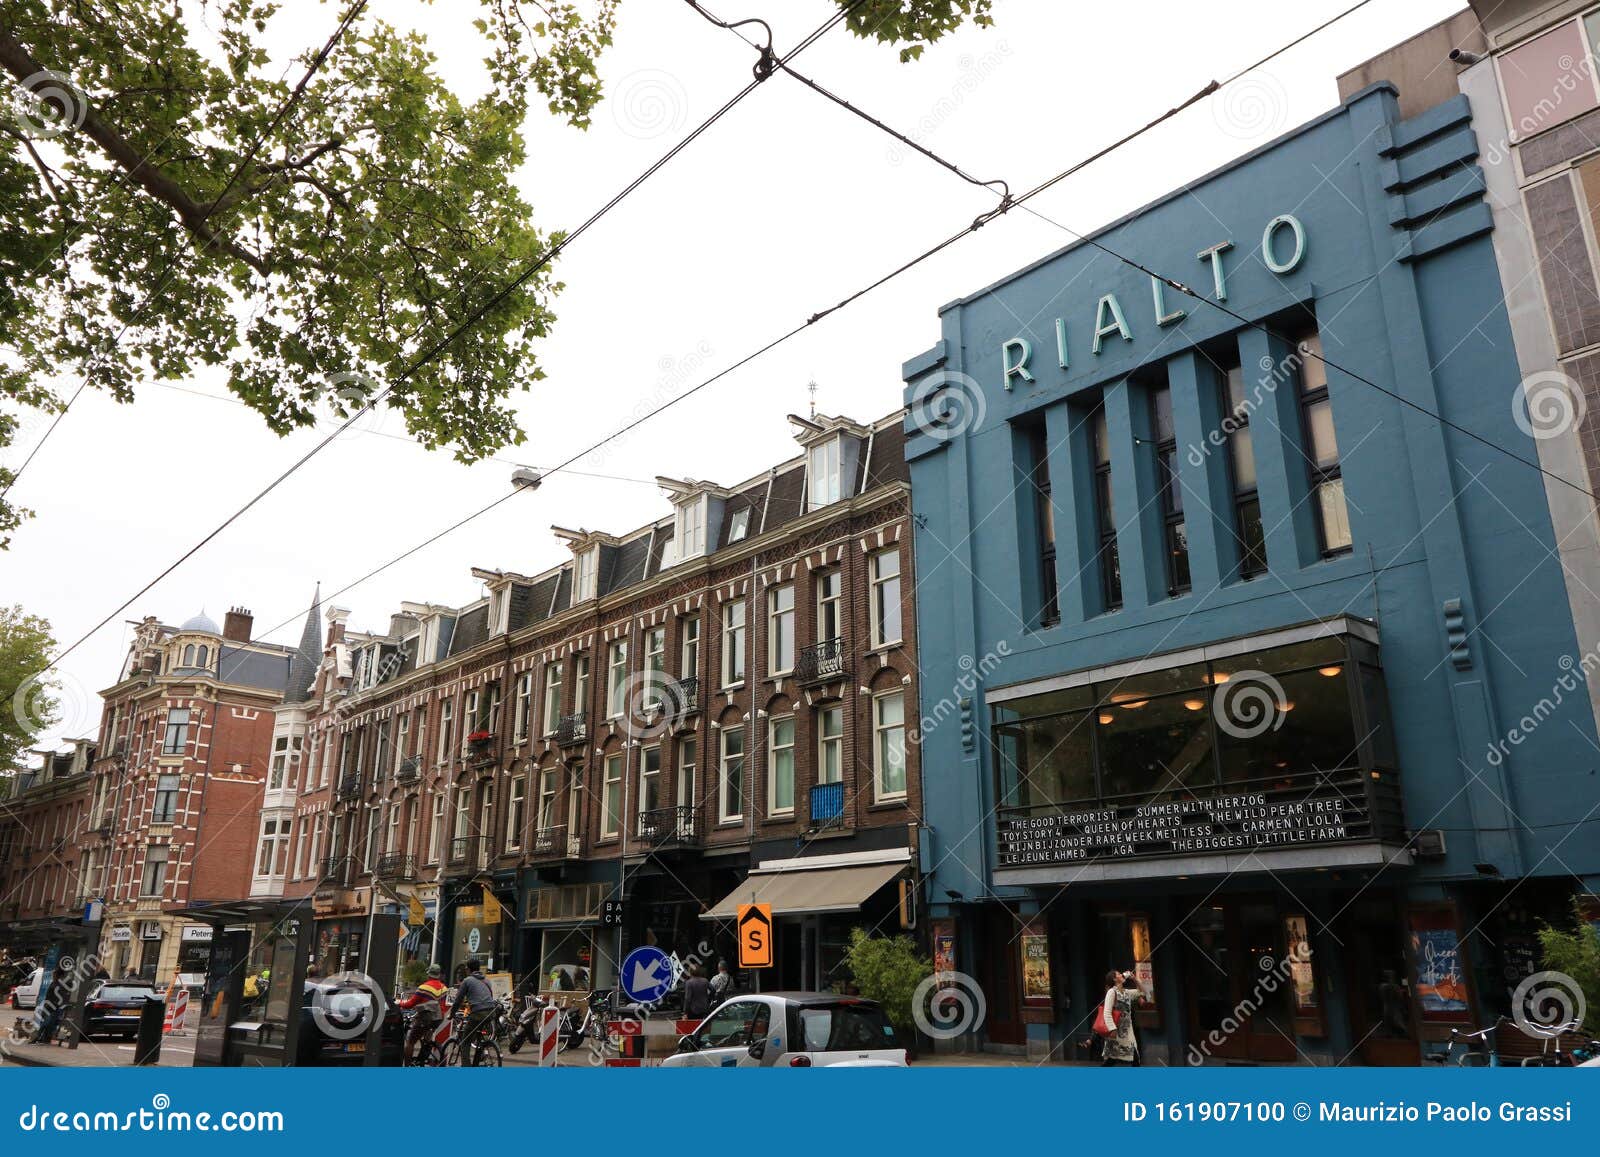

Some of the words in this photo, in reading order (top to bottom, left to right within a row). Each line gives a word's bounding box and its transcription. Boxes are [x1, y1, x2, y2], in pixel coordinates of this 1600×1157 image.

[1002, 214, 1306, 392] RIALTO
[1137, 804, 1180, 818] SUMMER
[1182, 800, 1212, 812] WITH
[1217, 795, 1264, 809] HERZOG
[1210, 811, 1232, 822] THE
[1235, 808, 1266, 820] WILD
[1270, 804, 1304, 817] PEAR
[1308, 800, 1342, 812] TREE
[1011, 821, 1028, 830] THE
[1030, 818, 1054, 828] GOOD
[1057, 811, 1115, 825] TERRORIST
[1084, 823, 1119, 834] QUEEN
[1121, 820, 1133, 831] OF
[1137, 816, 1180, 829] HEARTS
[1243, 818, 1292, 832] CARMEN
[1295, 817, 1302, 828] Y
[1306, 814, 1341, 827] LOLA
[1003, 832, 1020, 841] TOY
[1022, 830, 1053, 840] STORY
[1055, 828, 1061, 836] 4
[1009, 842, 1033, 852] MIJN
[1035, 836, 1092, 850] BIJZONDER
[1096, 833, 1122, 845] RARE
[1125, 831, 1153, 842] WEEK
[1156, 828, 1177, 840] MET
[1182, 825, 1211, 837] TESS
[1172, 839, 1193, 851] THE
[1196, 835, 1250, 849] BIGGEST
[1256, 830, 1306, 844] LITTLE
[1310, 827, 1345, 840] FARM
[1006, 854, 1017, 864] LE
[1020, 851, 1050, 862] JEUNE
[1054, 849, 1085, 860] AHMED
[1113, 844, 1134, 855] AGA
[749, 931, 763, 951] S
